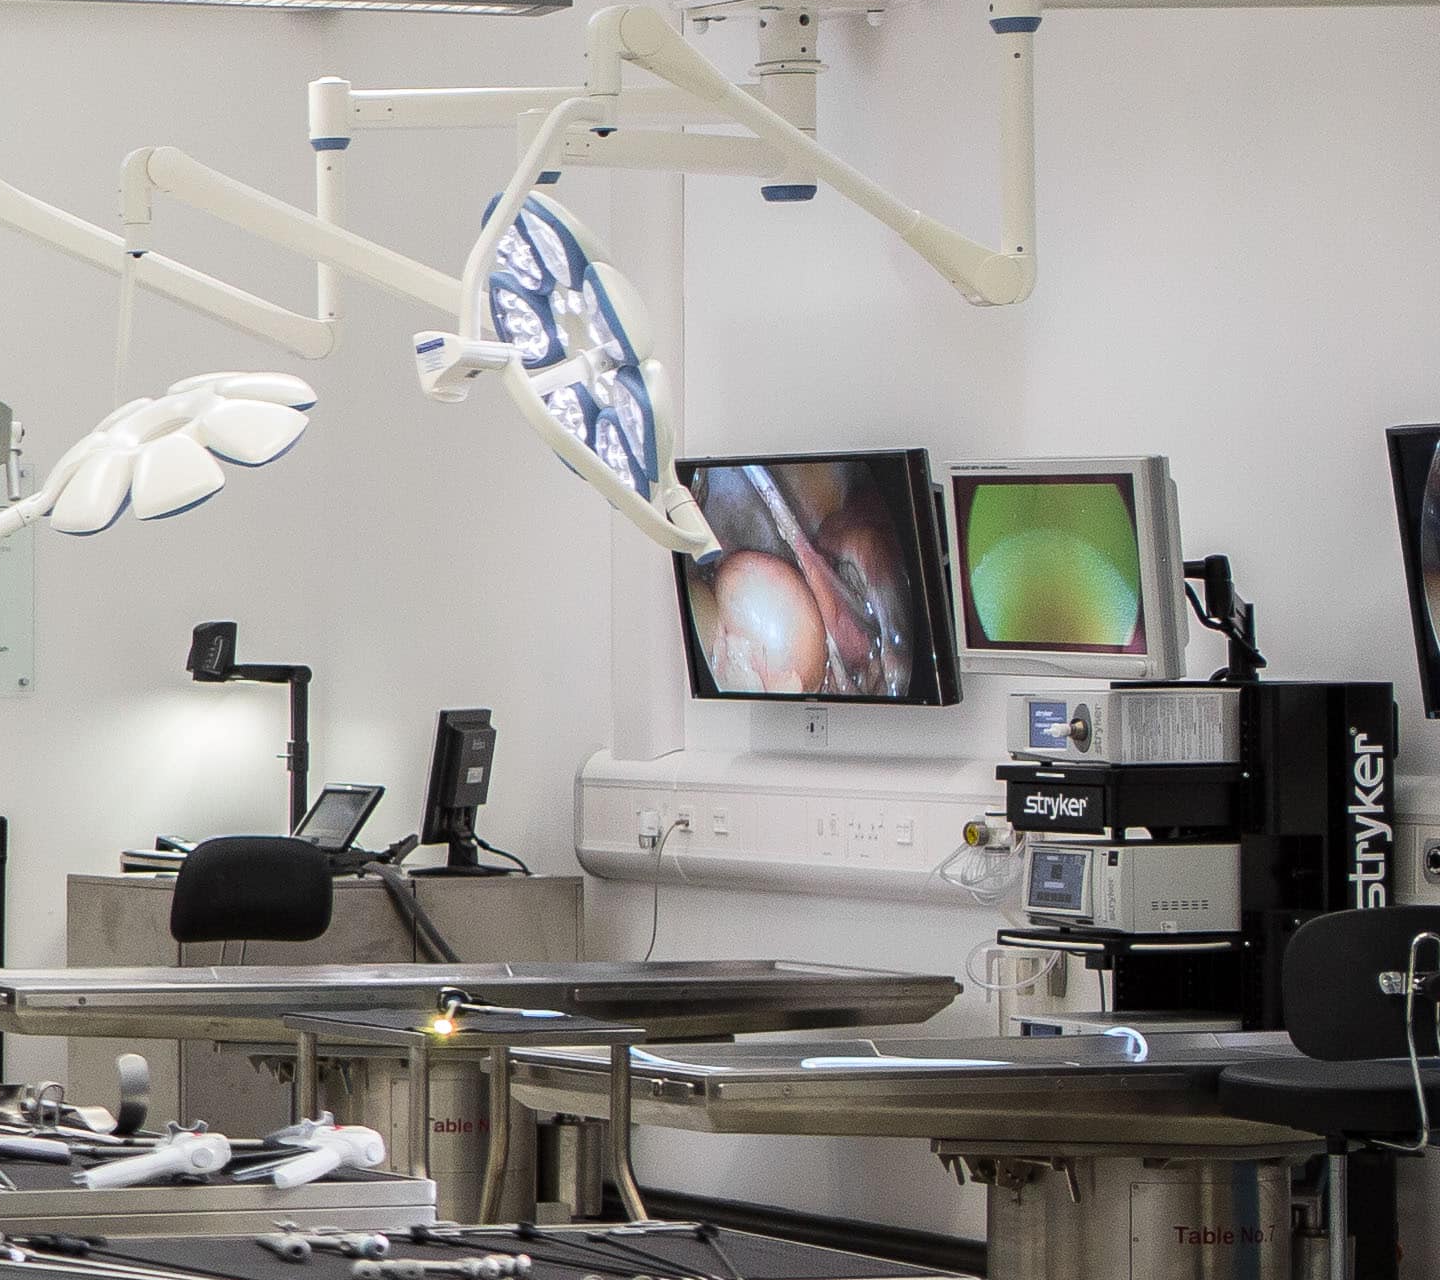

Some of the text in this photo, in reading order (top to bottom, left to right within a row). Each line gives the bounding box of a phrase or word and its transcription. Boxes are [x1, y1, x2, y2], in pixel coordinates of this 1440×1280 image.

[1024, 792, 1088, 820] stryker
[429, 1117, 473, 1134] able
[1173, 1224, 1275, 1245] Table No.7
